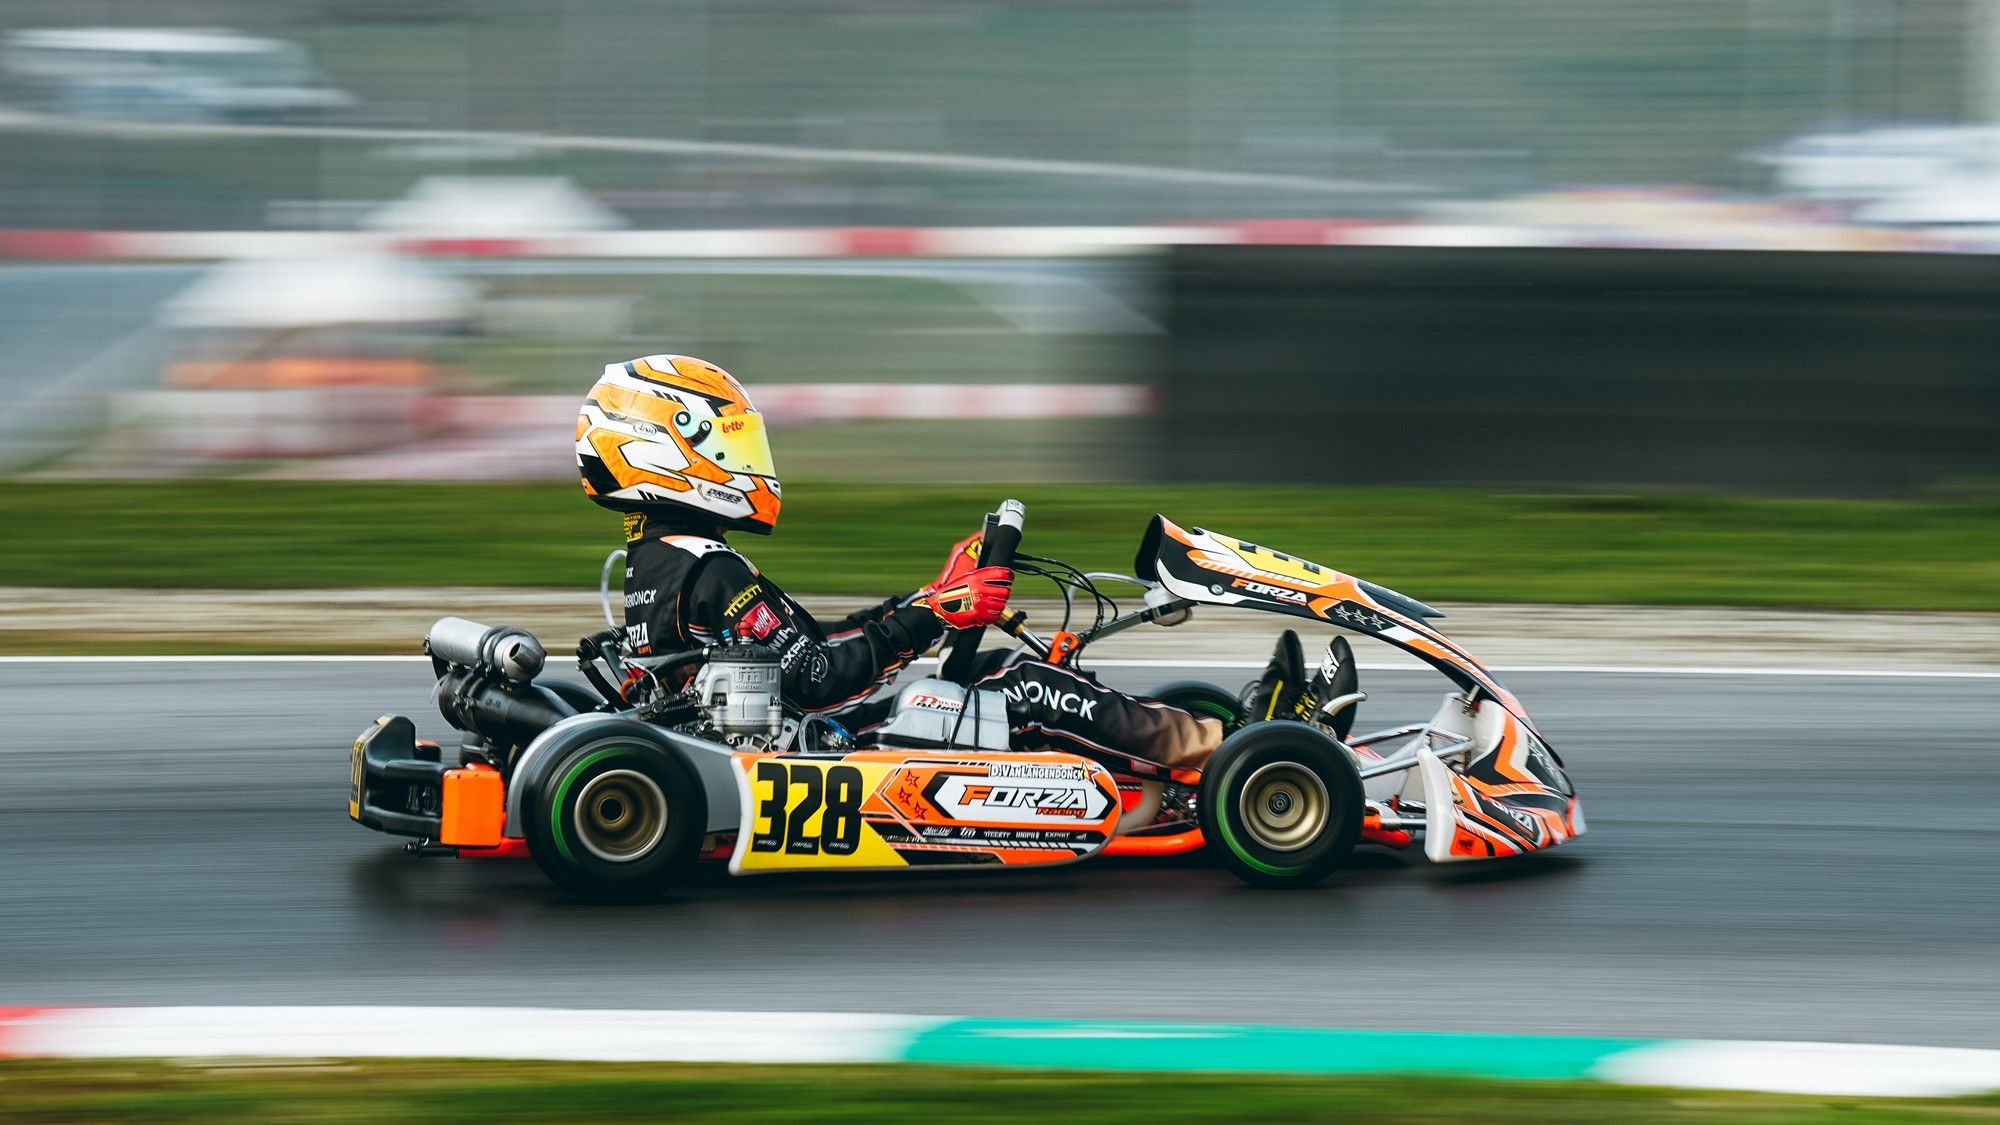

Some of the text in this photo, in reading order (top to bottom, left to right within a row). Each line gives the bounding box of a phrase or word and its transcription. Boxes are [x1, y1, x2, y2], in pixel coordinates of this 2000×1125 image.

[1231, 578, 1307, 603] FORZA
[751, 762, 863, 856] 328
[958, 784, 1088, 810] FORZA
[1035, 806, 1088, 819] Racing
